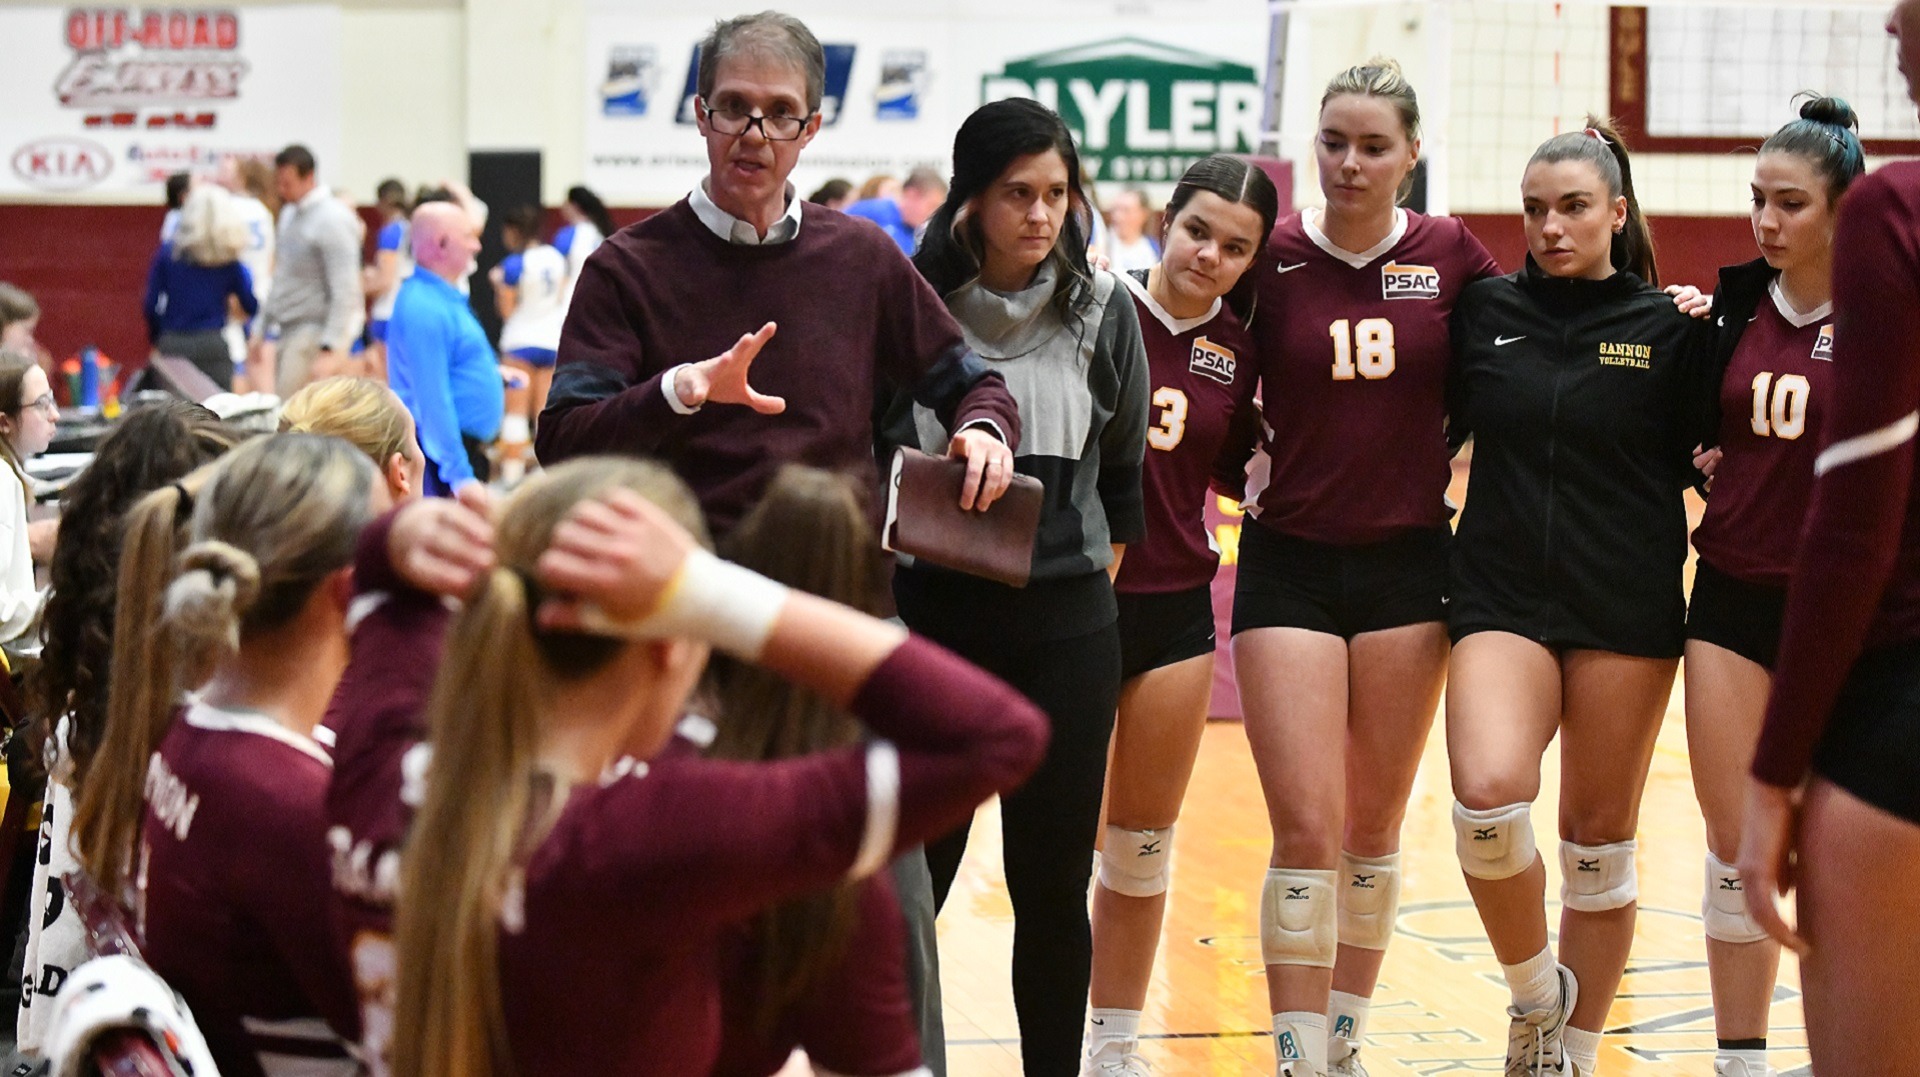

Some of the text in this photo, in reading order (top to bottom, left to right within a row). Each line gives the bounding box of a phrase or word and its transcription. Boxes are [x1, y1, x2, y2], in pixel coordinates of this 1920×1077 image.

[30, 153, 94, 177] KIA
[1384, 274, 1438, 290] PSAC
[1192, 347, 1235, 375] PSAC
[1329, 317, 1396, 381] 18
[1599, 342, 1652, 359] GANNON
[1599, 356, 1650, 369] VOLLEYBALL
[1750, 371, 1811, 440] 10
[1147, 386, 1188, 452] 3
